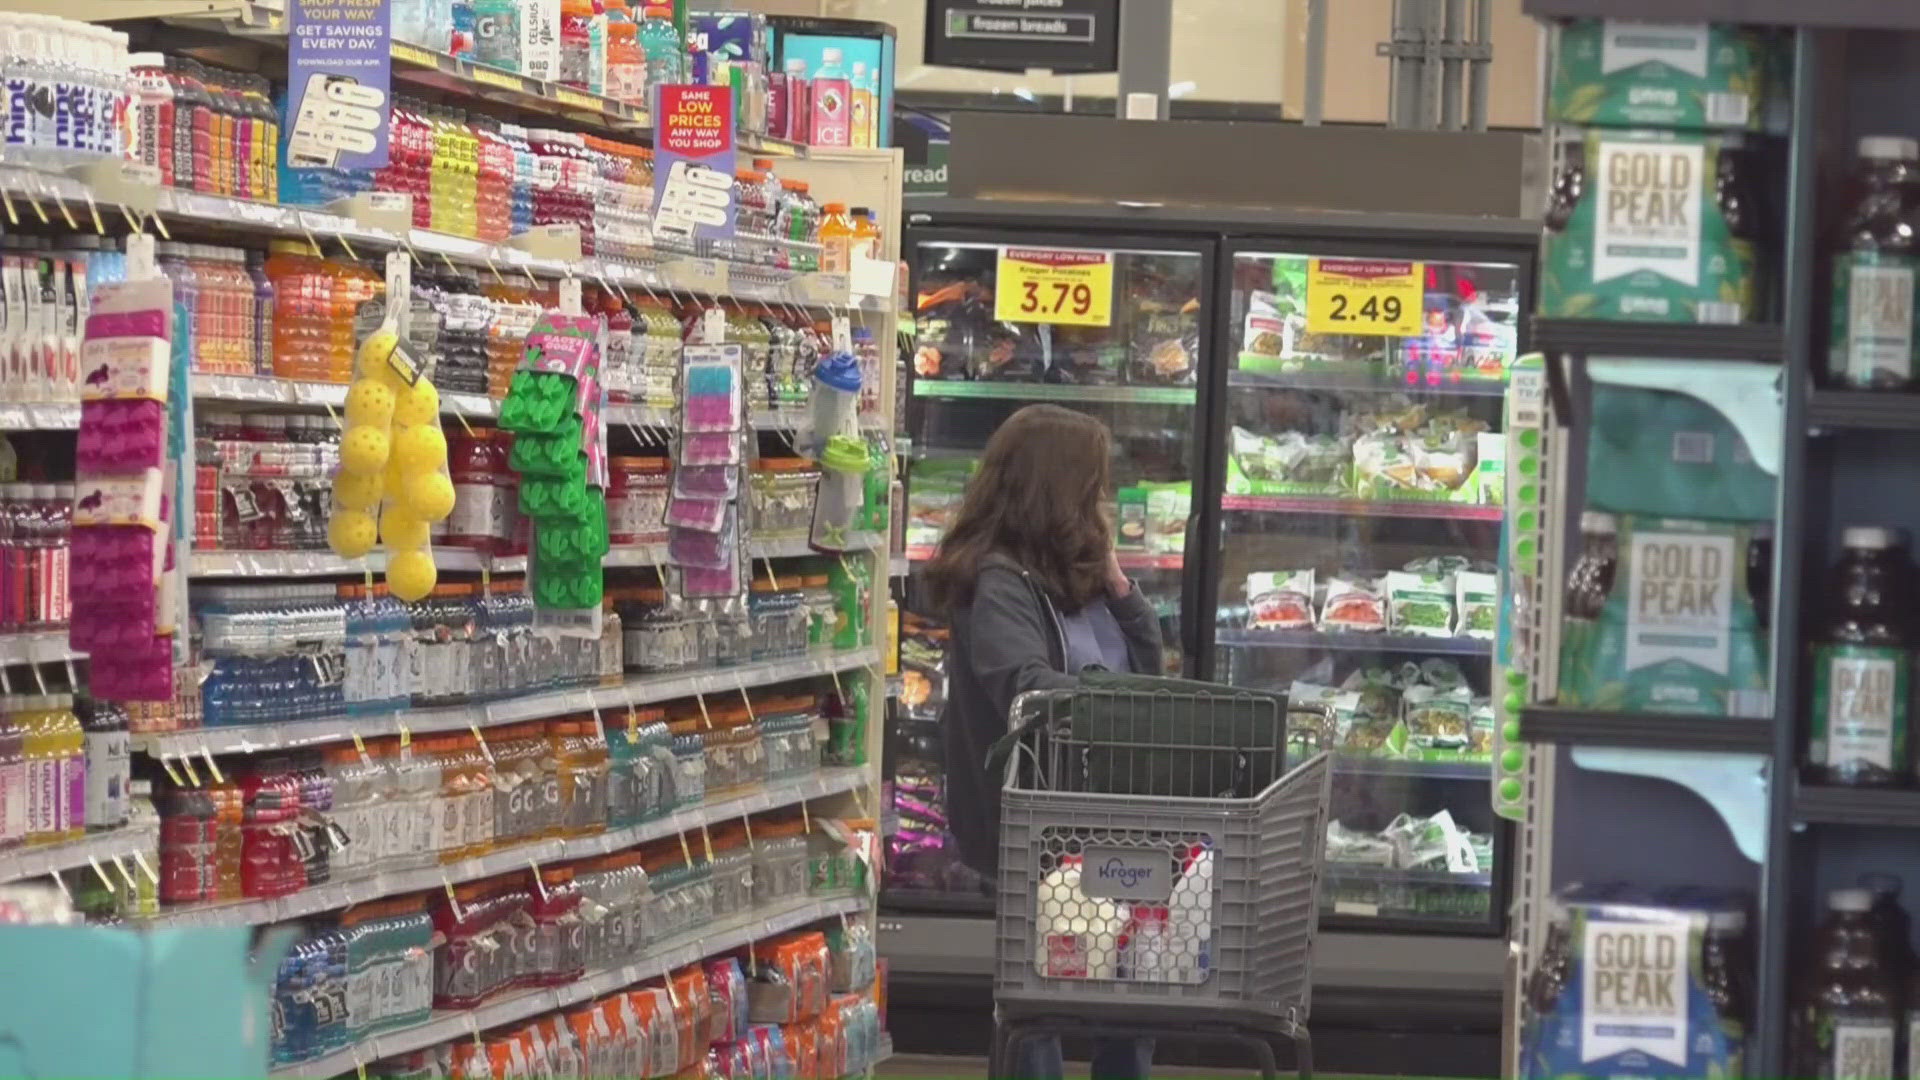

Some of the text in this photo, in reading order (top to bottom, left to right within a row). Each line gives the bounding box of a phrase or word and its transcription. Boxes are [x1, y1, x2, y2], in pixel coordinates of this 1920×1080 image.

[304, 9, 376, 20] YOUR WAY.
[296, 25, 383, 36] GET SAVINGS
[478, 17, 494, 38] G
[302, 38, 376, 49] EVERY DAY.
[297, 58, 344, 66] DOWNLOAD
[346, 58, 362, 66] OUR
[681, 91, 710, 100] SAME
[6, 80, 25, 143] hint
[678, 101, 713, 113] LOW
[668, 115, 722, 127] PRICES
[671, 128, 719, 138] ANY WAY
[817, 127, 844, 144] ICE
[668, 138, 722, 148] YOU SHOP
[1608, 152, 1692, 190] GOLD
[1607, 190, 1689, 226] PEAK
[1009, 252, 1102, 261] EVERYDAY LOW PRICE
[1321, 264, 1409, 273] EVERYDAY LOW PRICE
[1020, 281, 1092, 315] 3.79
[1329, 294, 1402, 322] 2.49
[1642, 543, 1722, 581] GOLD
[1639, 581, 1720, 617] PEAK
[40, 762, 50, 828] vitamin
[1100, 858, 1152, 888] Kroger
[1594, 934, 1676, 970] GOLD
[1594, 971, 1674, 1007] PEAK
